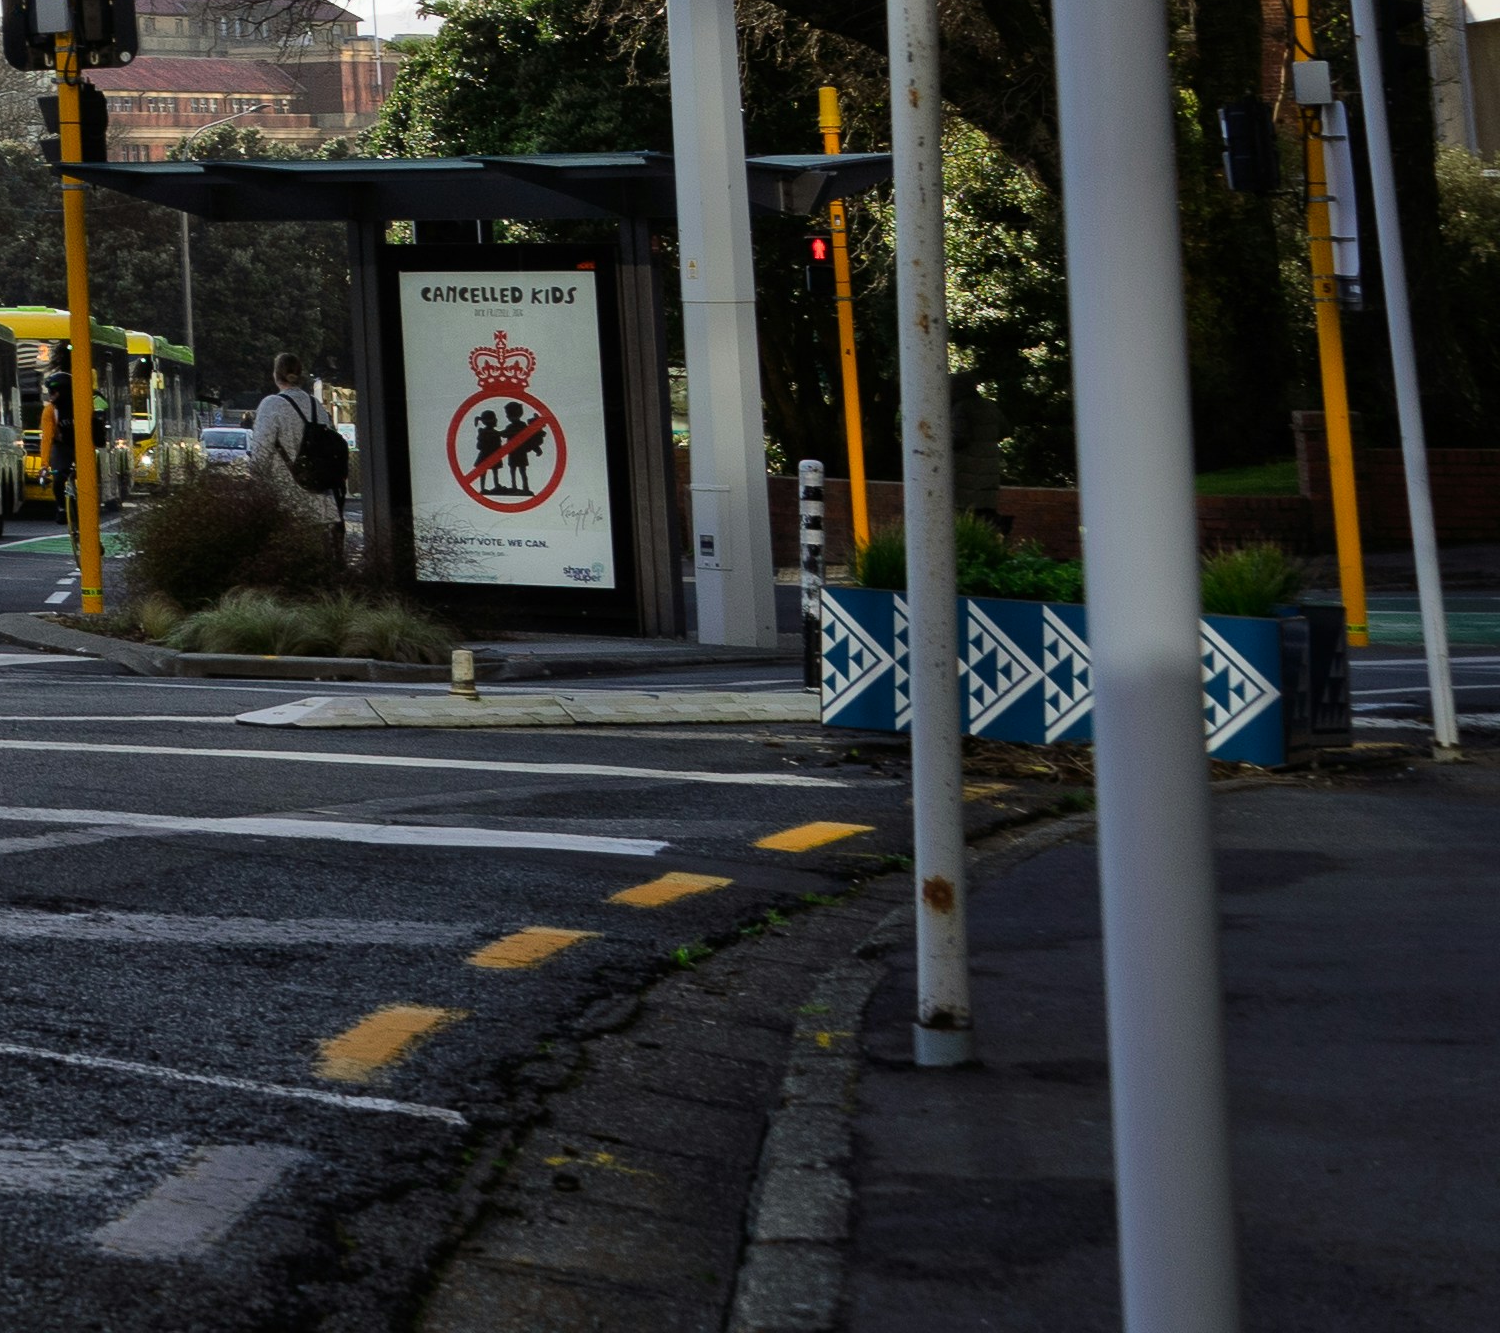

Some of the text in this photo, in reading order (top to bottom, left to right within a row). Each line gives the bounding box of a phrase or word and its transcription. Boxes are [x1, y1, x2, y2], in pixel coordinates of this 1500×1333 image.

[420, 285, 577, 304] CANCELLED KIDS
[478, 537, 504, 547] VOTE.
[507, 539, 522, 548] WE
[525, 539, 549, 548] CAN.
